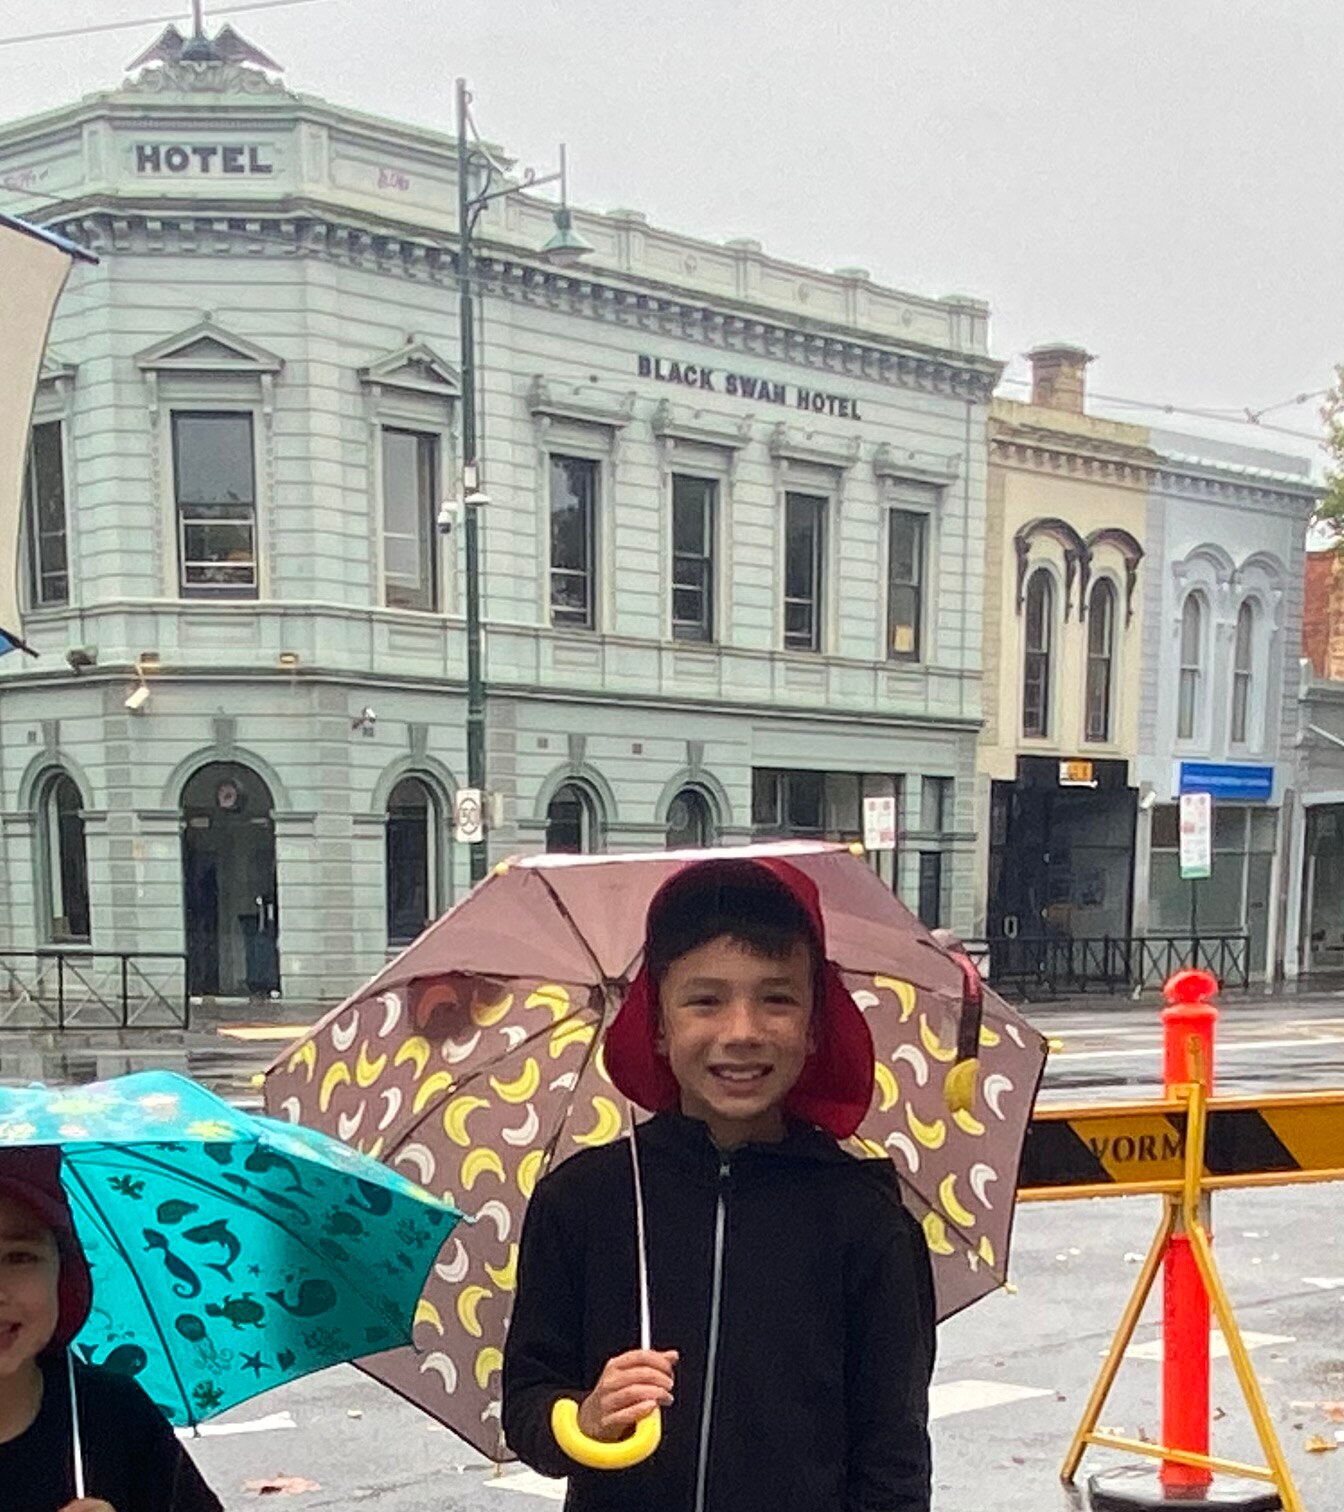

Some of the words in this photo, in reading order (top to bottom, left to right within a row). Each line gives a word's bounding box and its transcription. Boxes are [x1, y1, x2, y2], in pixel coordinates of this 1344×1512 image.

[135, 144, 273, 174] HOTEL
[636, 354, 715, 392] BLACK
[724, 372, 787, 406] SWAN
[796, 387, 862, 421] HOTEL
